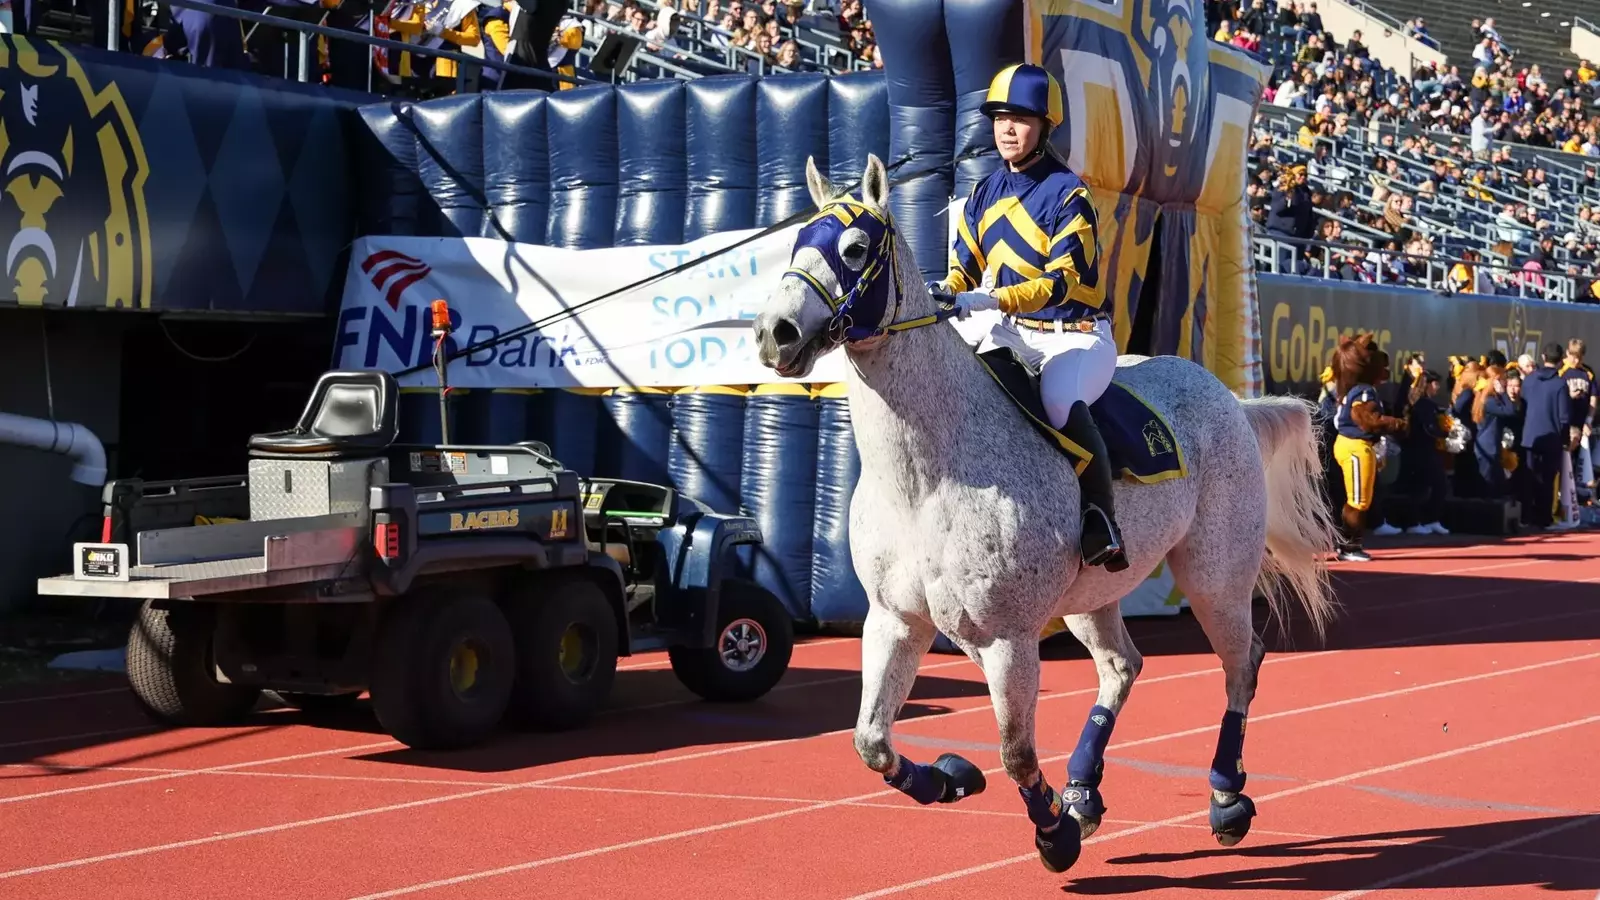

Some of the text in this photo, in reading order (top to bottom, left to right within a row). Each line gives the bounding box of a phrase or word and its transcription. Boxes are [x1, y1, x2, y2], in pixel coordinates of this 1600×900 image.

[333, 305, 581, 368] FNB Bank
[450, 509, 519, 531] RACERS
